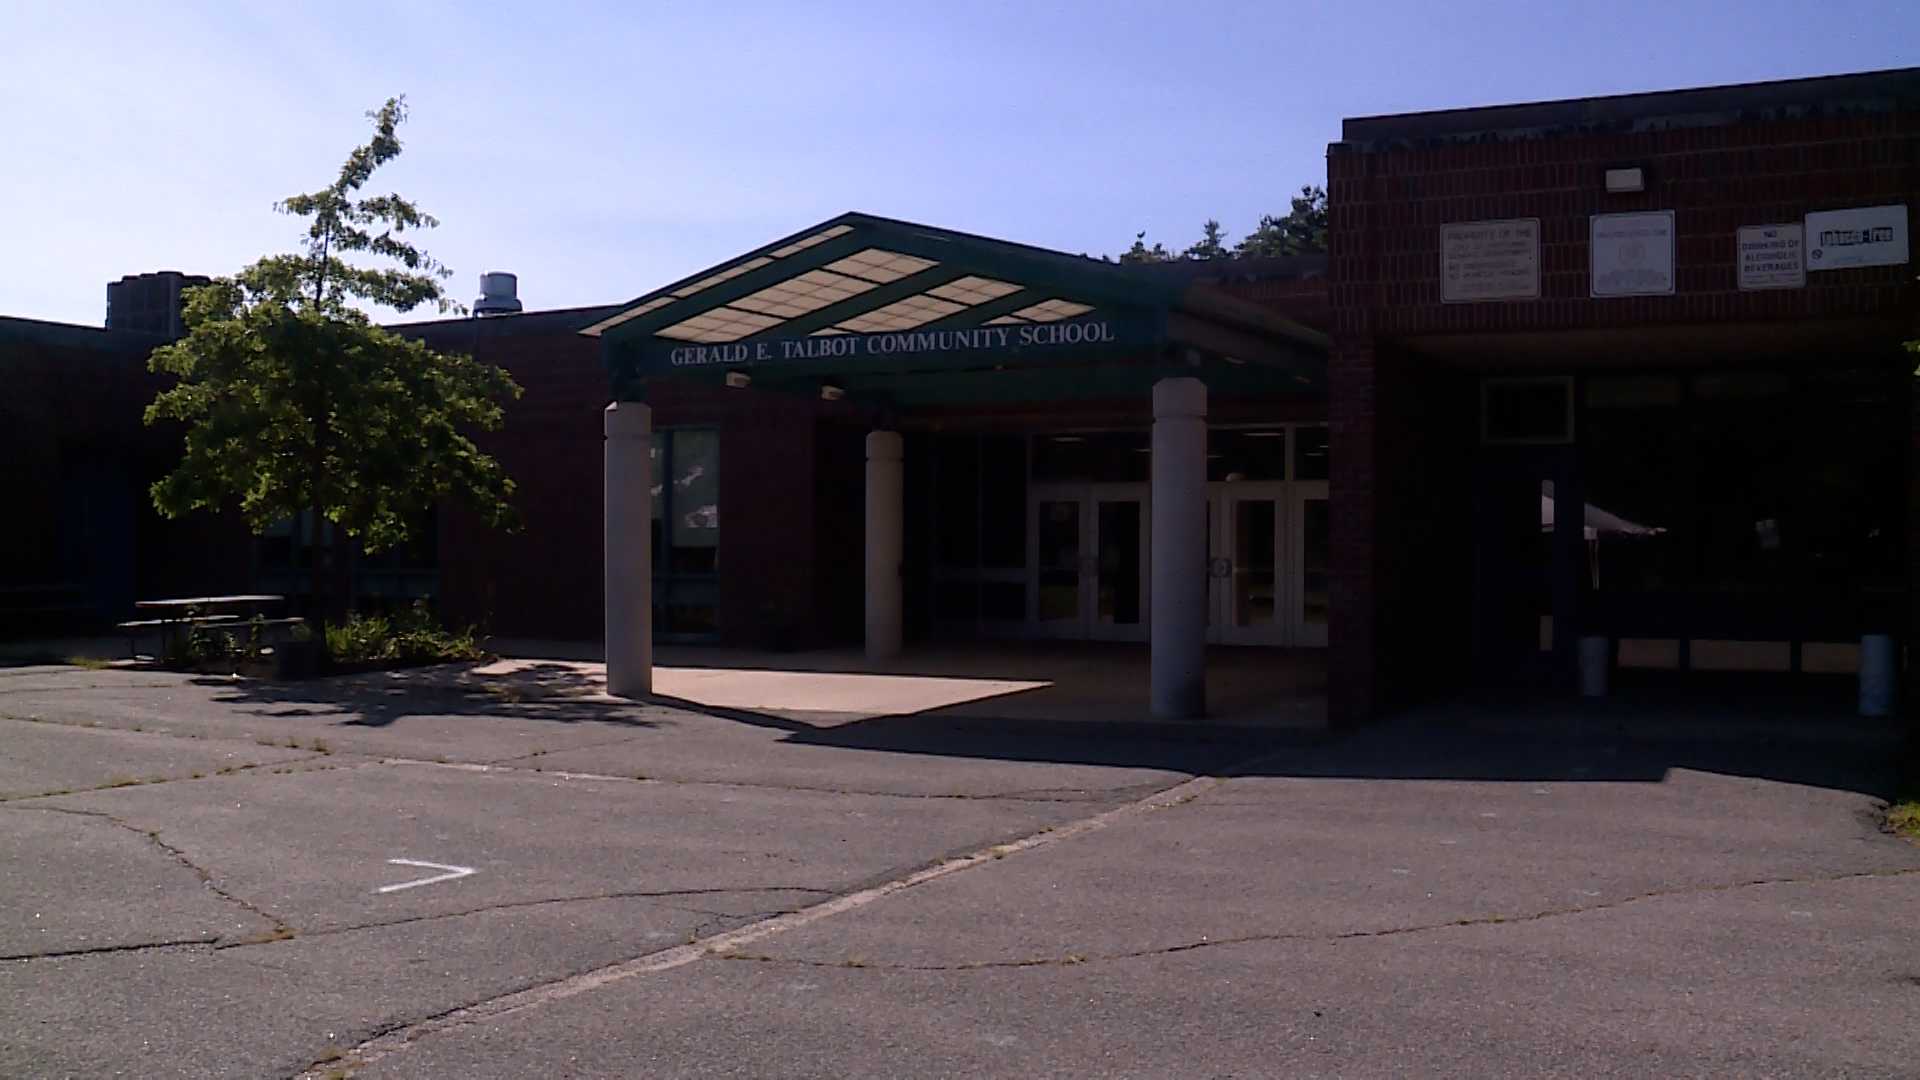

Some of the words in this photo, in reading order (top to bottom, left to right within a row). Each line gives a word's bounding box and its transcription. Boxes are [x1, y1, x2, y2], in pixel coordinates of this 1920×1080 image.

[670, 344, 748, 366] GERALD
[756, 342, 773, 361] E.
[781, 336, 860, 359] TALBOT
[866, 326, 1010, 355] COMMUNITY
[1018, 321, 1115, 346] SCHOOL
